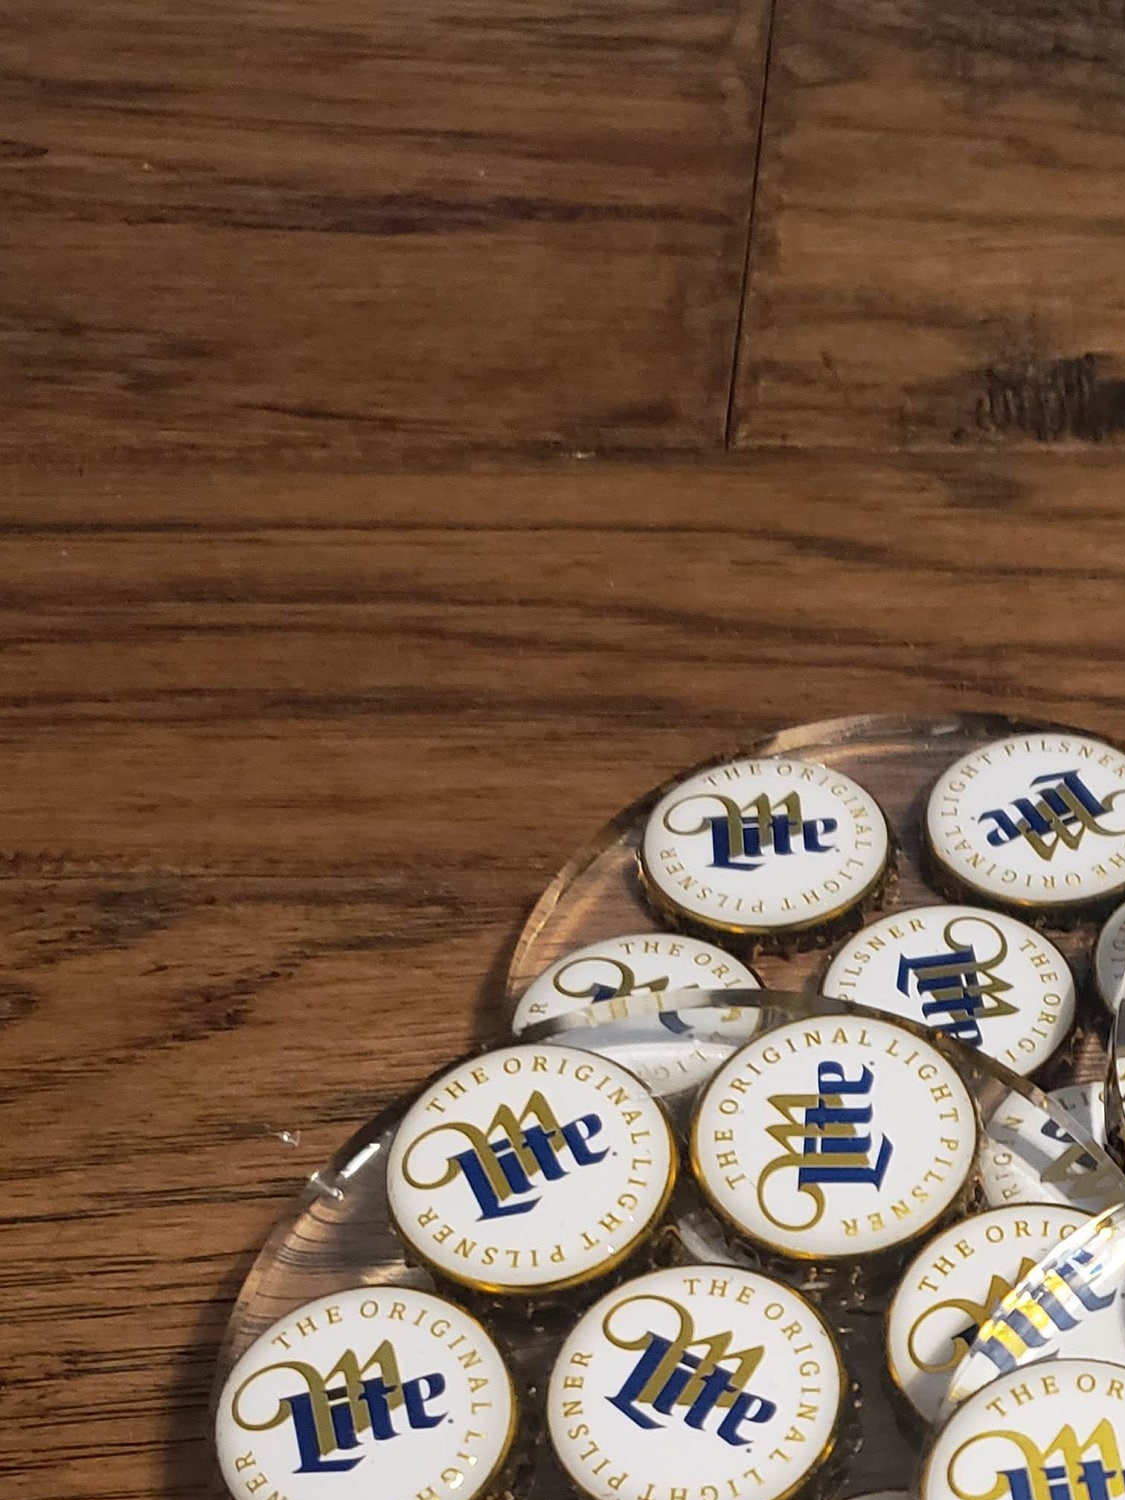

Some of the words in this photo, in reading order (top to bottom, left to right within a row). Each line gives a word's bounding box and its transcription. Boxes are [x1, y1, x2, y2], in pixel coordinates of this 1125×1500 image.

[701, 762, 763, 787] THE
[776, 763, 874, 850] ORIGINAL
[938, 750, 993, 817] LIGHT
[654, 847, 765, 915] PILSNER
[780, 858, 865, 913] LIGHT
[943, 826, 1082, 890] ORIGINAL
[619, 941, 684, 958] THE
[1020, 938, 1059, 984] THE
[1004, 994, 1061, 1063] ORIGI
[423, 1067, 489, 1112] THE
[502, 1055, 651, 1145] ORIGINAL
[717, 1026, 872, 1116] ORIGINAL
[884, 1038, 962, 1123] LIGHT
[711, 1129, 745, 1191] THE
[841, 1137, 961, 1241] PILSNER
[412, 1207, 567, 1270] PILSNER
[580, 1158, 653, 1253] LIGHT
[683, 1277, 756, 1305] THE
[918, 1239, 975, 1293] THE
[270, 1305, 343, 1349] THE
[358, 1300, 493, 1415] ORIGINAL
[763, 1302, 822, 1463] ORIGINAL
[559, 1350, 629, 1492] PILSNER
[985, 1374, 1059, 1417] THE
